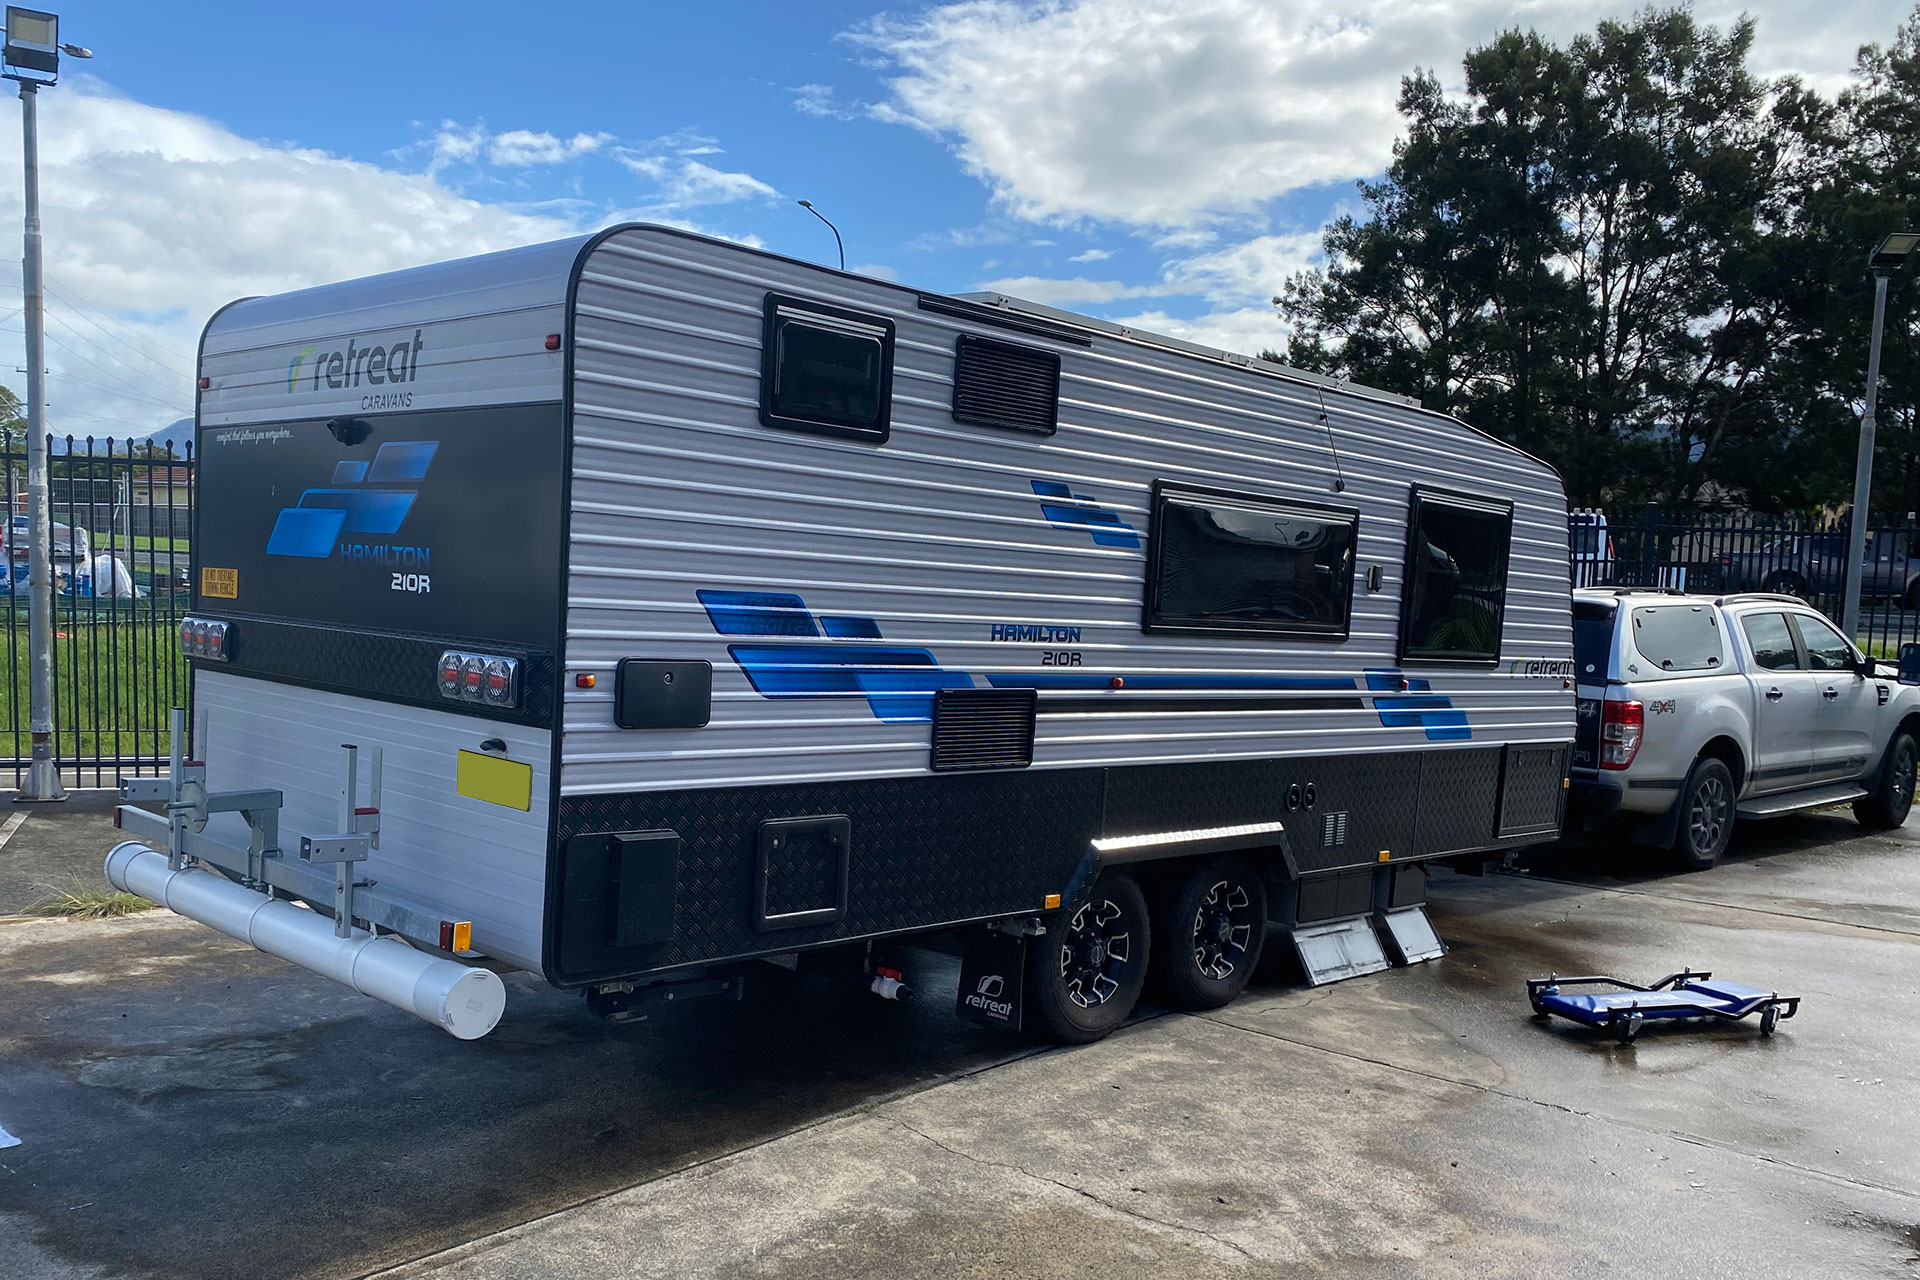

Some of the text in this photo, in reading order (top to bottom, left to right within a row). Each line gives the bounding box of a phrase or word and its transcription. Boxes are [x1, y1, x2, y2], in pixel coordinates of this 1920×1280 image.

[313, 329, 424, 391] retreat
[361, 392, 413, 411] CARAVANS
[340, 543, 430, 567] HAMILTON
[391, 572, 430, 594] 210R
[991, 624, 1082, 643] HAMILTON
[1042, 651, 1082, 667] 210R
[1524, 655, 1573, 679] retreat
[965, 995, 1013, 1016] retreat
